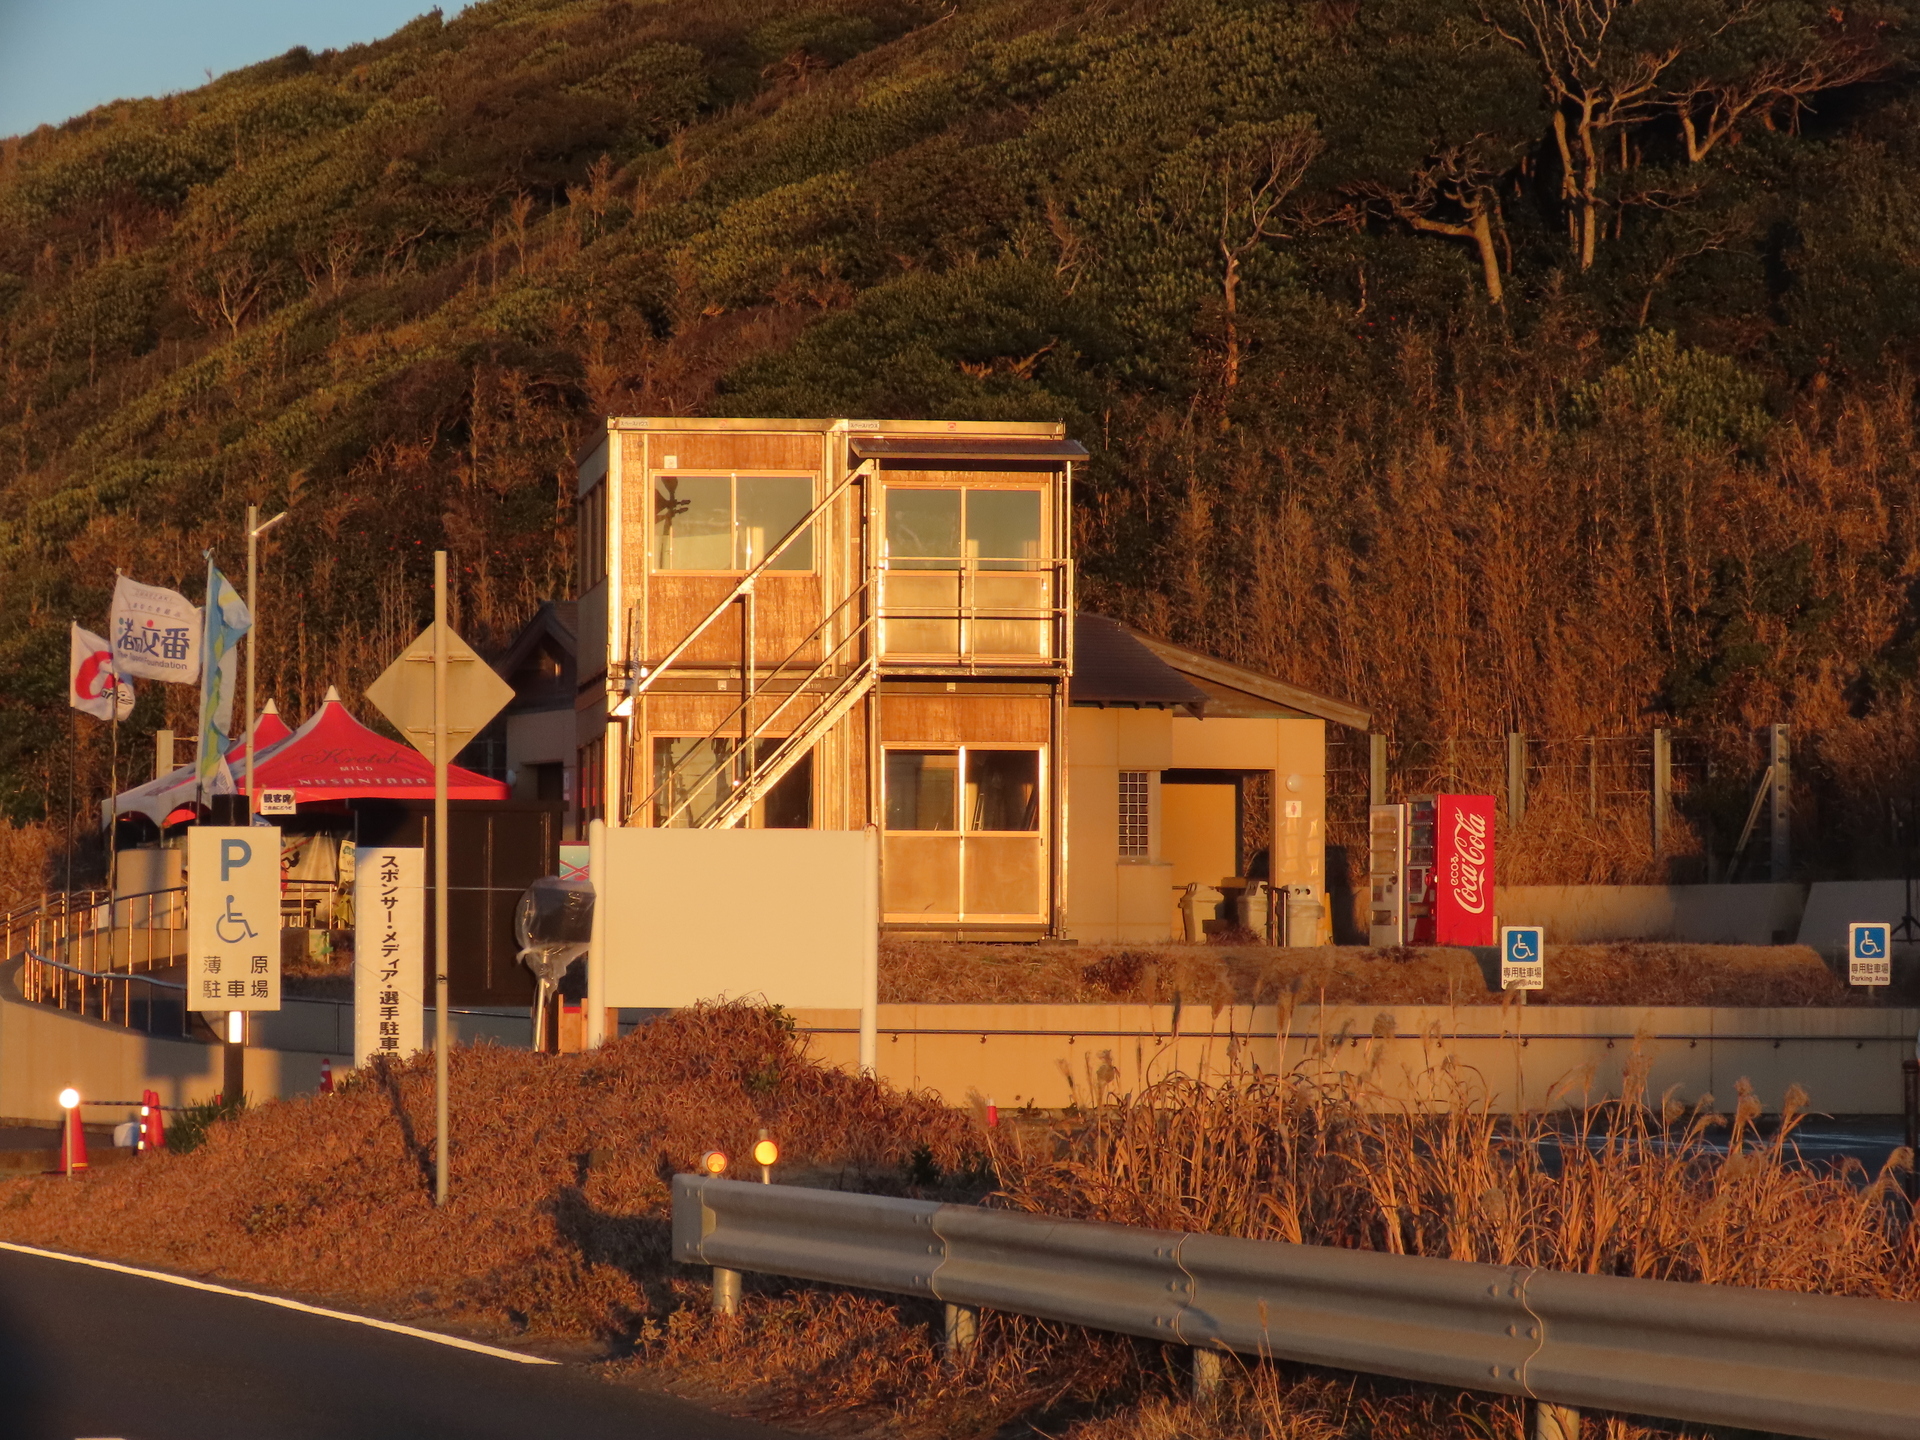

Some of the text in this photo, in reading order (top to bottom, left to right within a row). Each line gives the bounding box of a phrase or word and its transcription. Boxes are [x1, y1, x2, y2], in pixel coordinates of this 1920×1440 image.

[220, 838, 252, 882] P
[1453, 806, 1487, 914] Coca-Cola
[379, 855, 400, 1057] スポンサー・メディア・選手駐車
[1503, 967, 1541, 978] 専用駐車場
[1851, 963, 1888, 974] 専用駐車場
[1851, 975, 1872, 983] Parking
[203, 980, 268, 998] 駐車場
